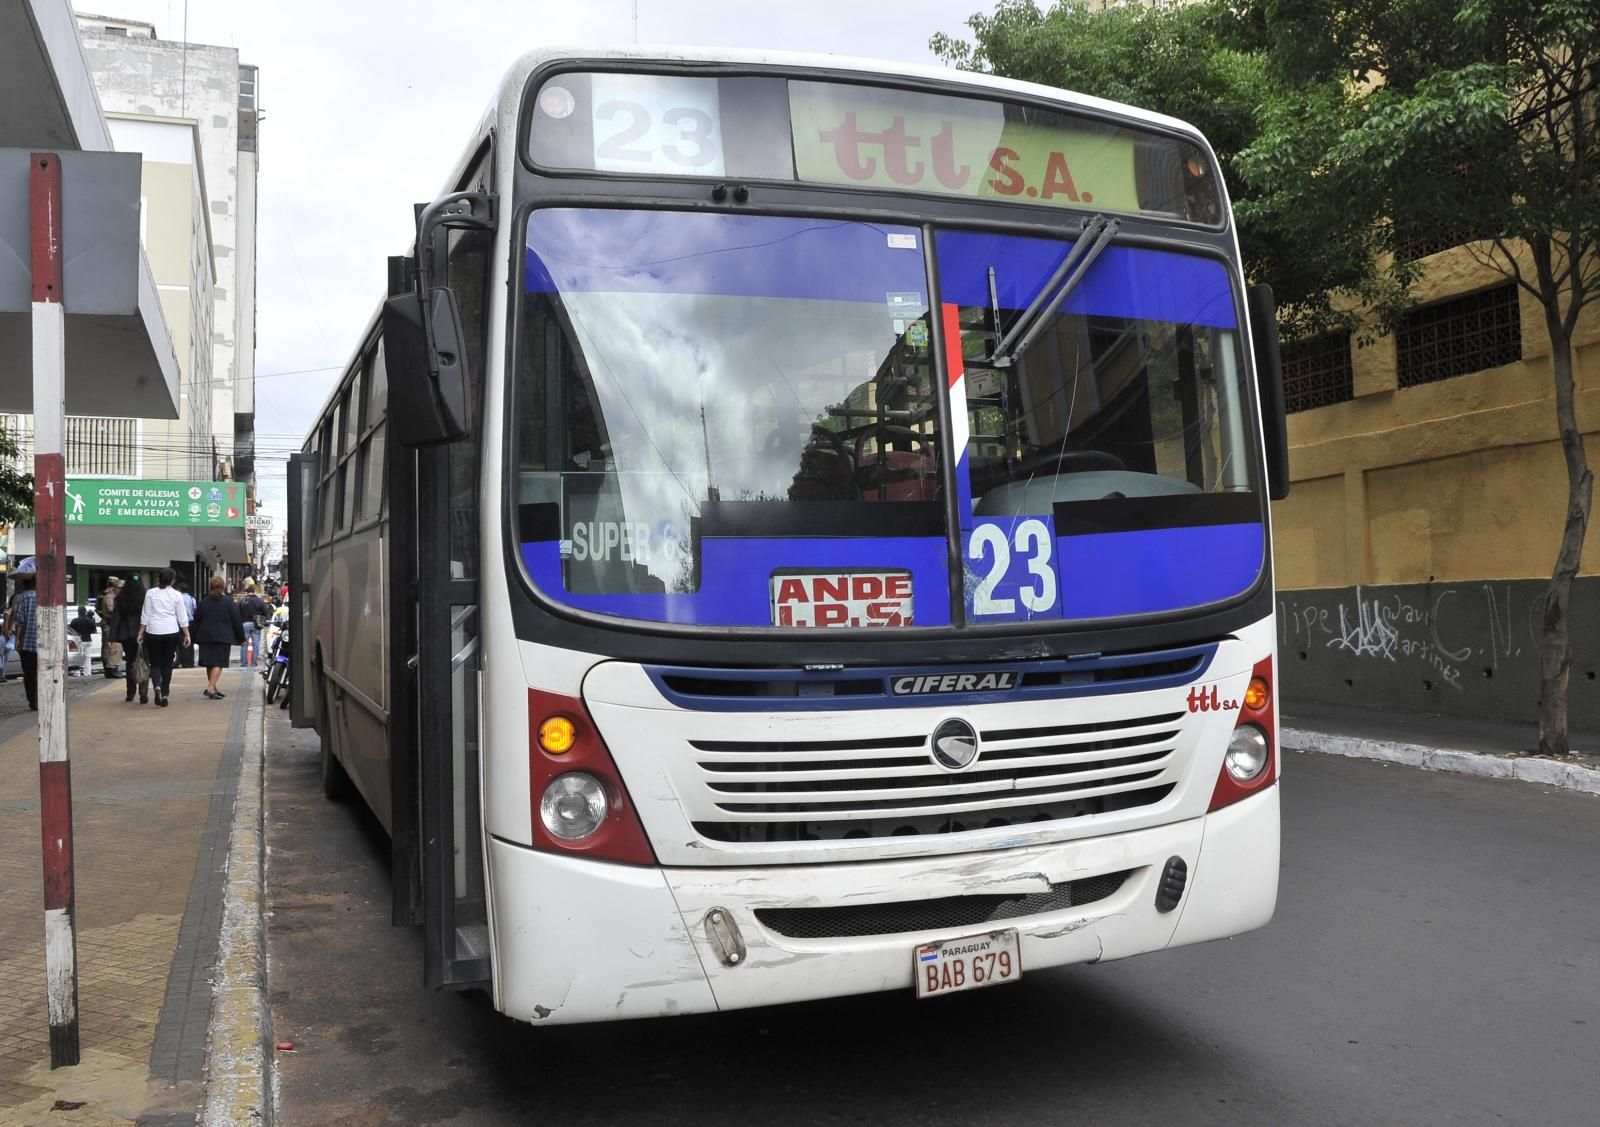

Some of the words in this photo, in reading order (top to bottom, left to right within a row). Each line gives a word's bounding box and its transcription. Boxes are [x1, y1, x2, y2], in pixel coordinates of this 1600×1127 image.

[596, 99, 718, 167] 23
[987, 147, 1093, 203] S.A.
[98, 498, 128, 506] PARA
[135, 499, 180, 507] AYUDAS
[99, 488, 130, 497] COMITE
[132, 489, 144, 497] DE
[145, 490, 180, 498] IGLESIAS
[98, 507, 112, 515] DE
[117, 508, 180, 517] EMERGENCIA
[572, 521, 650, 561] SUPER
[663, 521, 675, 561] 6
[968, 519, 1057, 616] 23
[777, 576, 913, 604] ANDE
[893, 671, 1014, 695] CIFERAL
[942, 942, 991, 958] PARAGUAY
[927, 959, 966, 992] BAB
[972, 950, 1012, 983] 679
